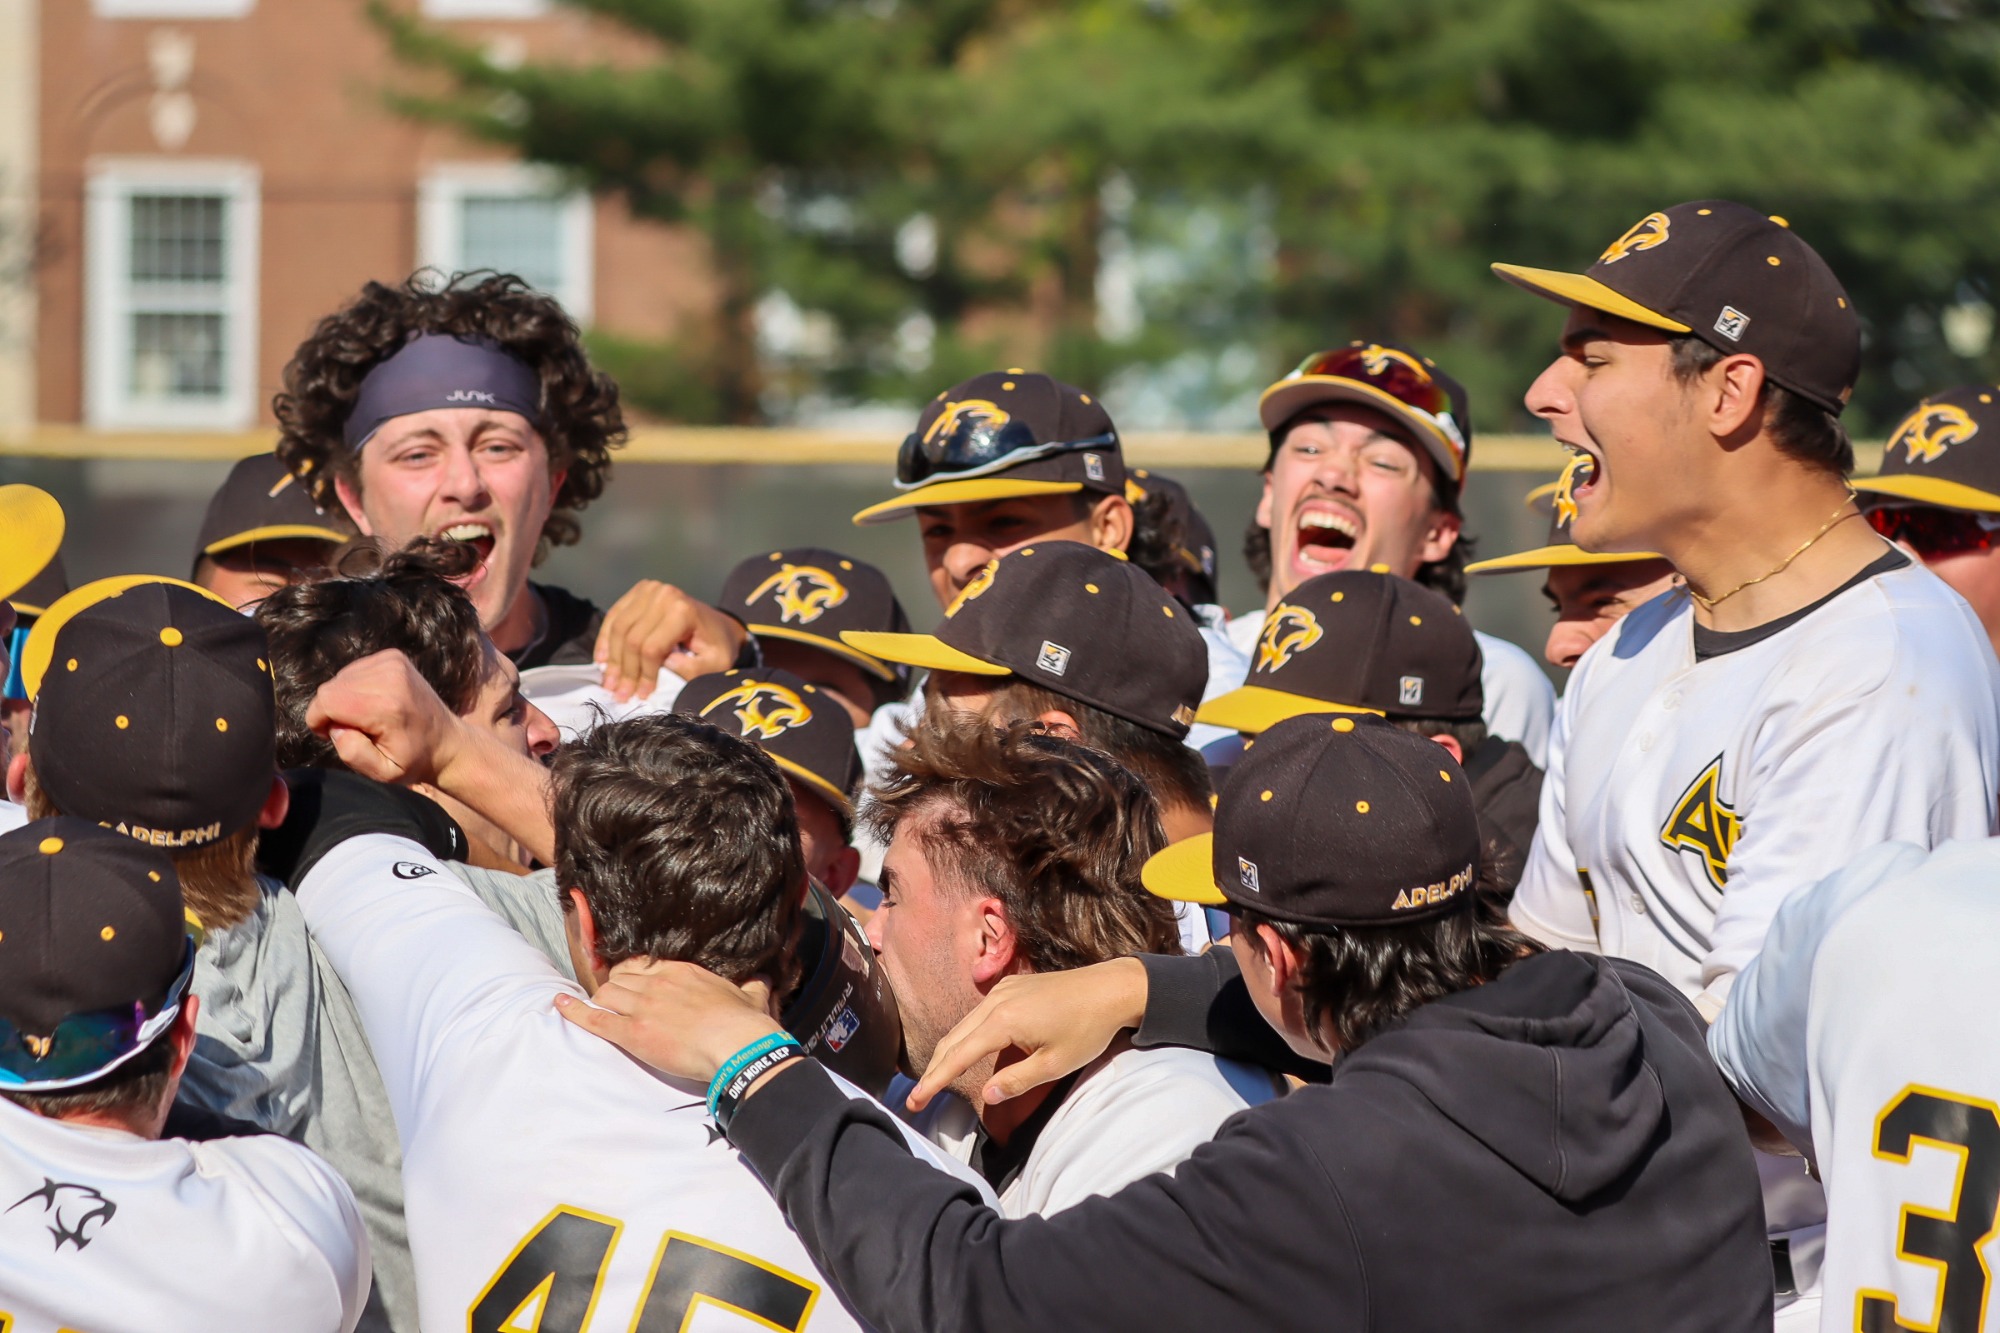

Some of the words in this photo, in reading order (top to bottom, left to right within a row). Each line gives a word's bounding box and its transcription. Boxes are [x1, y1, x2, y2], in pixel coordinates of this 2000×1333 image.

[728, 1075, 748, 1100] ONE
[743, 1054, 773, 1081] MORE
[768, 1046, 791, 1063] REP
[731, 1037, 776, 1067] Message
[1853, 1082, 2000, 1333] 3
